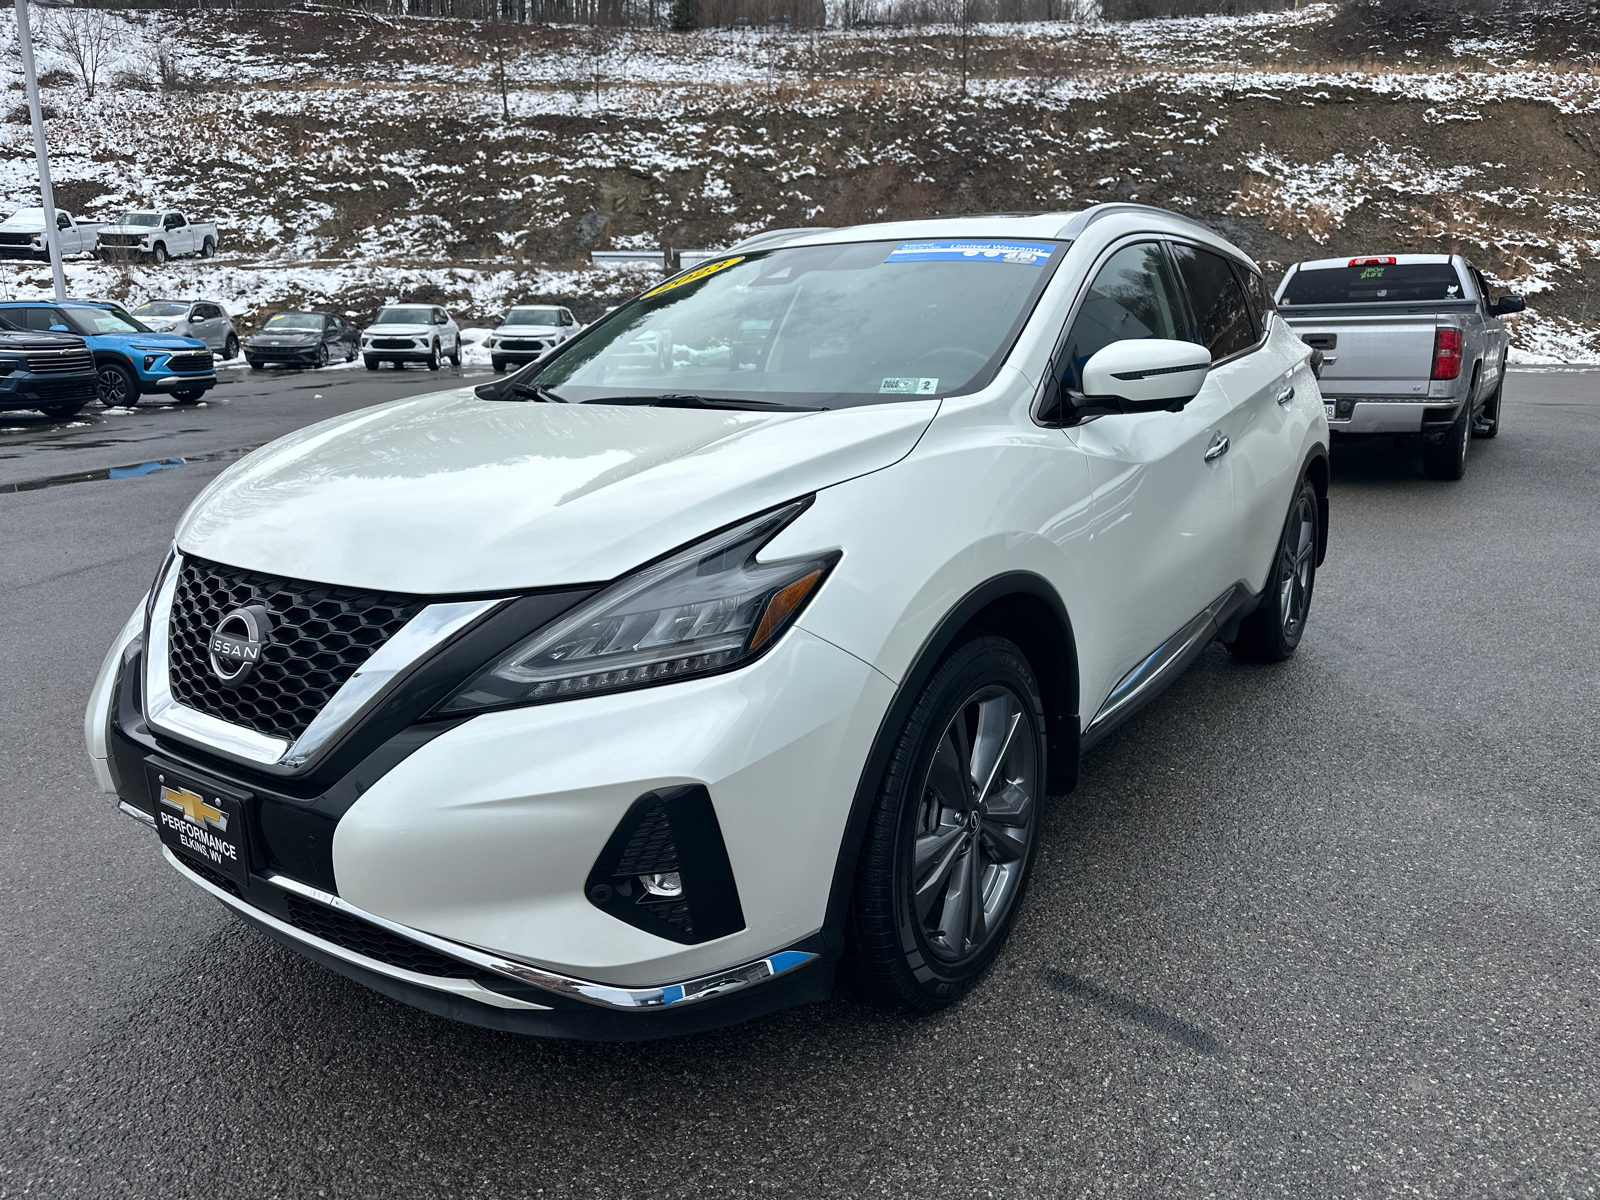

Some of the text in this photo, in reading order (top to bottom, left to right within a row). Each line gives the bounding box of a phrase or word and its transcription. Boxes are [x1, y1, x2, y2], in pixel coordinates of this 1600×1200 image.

[992, 244, 1045, 252] Warranty
[923, 380, 931, 390] 2
[211, 638, 258, 659] ISSAN
[160, 811, 238, 861] PERFORMANCE
[180, 833, 222, 865] ELKINS, WV
